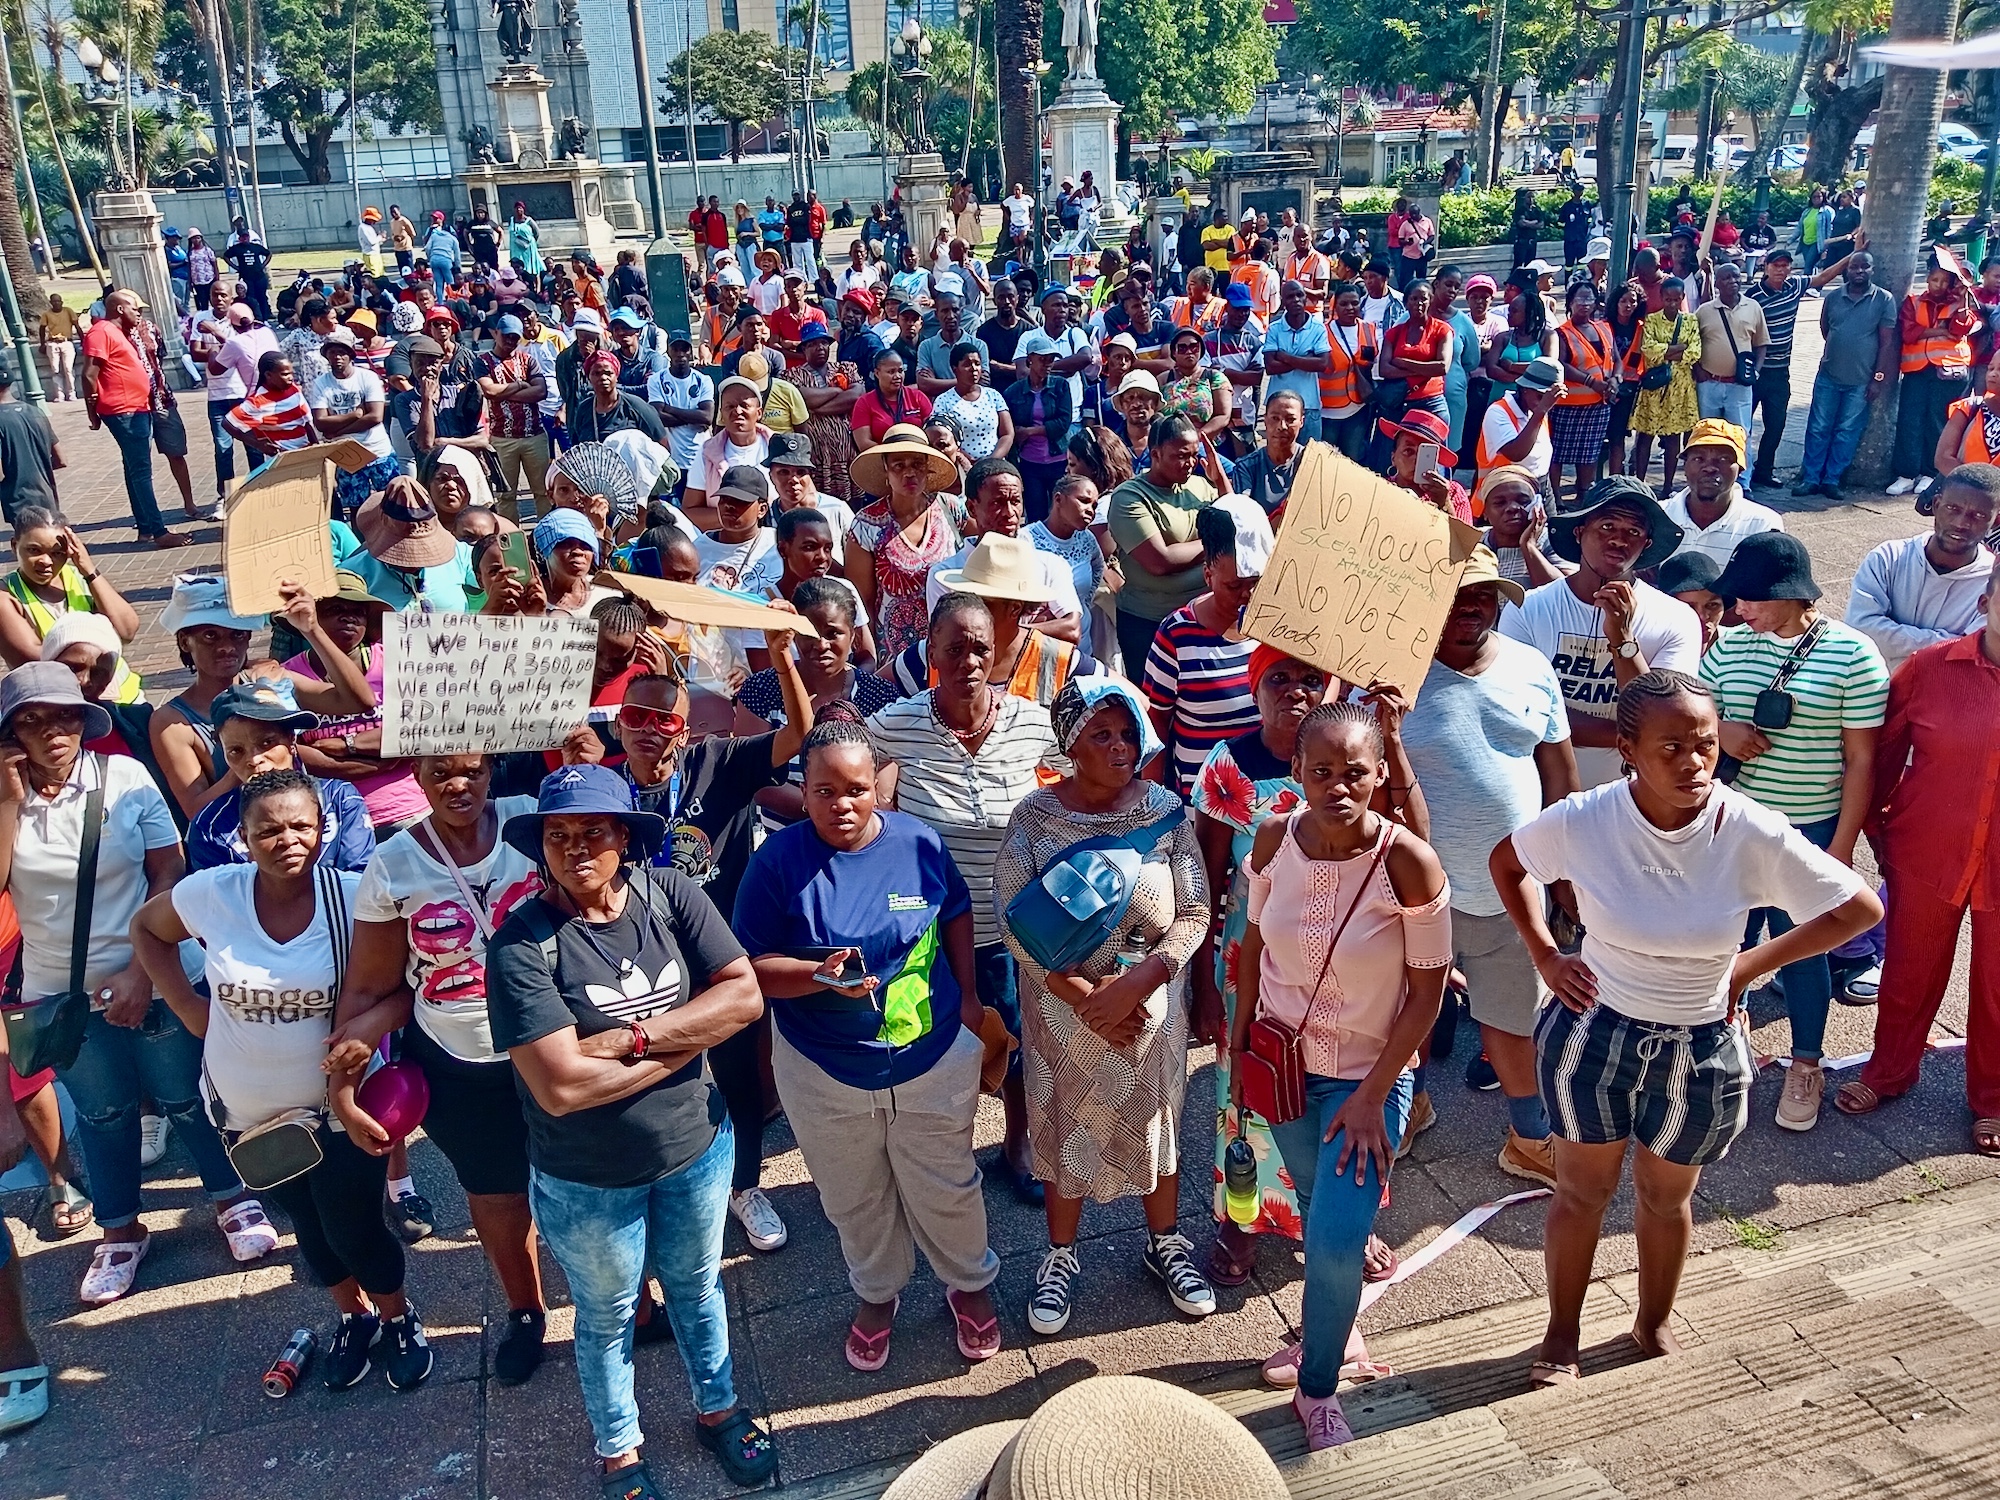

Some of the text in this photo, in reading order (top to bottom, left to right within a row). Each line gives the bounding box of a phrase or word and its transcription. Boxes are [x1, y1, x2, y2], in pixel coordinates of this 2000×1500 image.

[1291, 453, 1456, 594] No house
[1273, 554, 1429, 659] No Vote
[539, 619, 559, 632] us
[1246, 603, 1320, 656] Floods
[478, 631, 519, 653] have
[532, 636, 553, 651] an
[470, 654, 489, 679] of
[397, 676, 428, 699] We
[560, 676, 585, 695] for
[551, 699, 576, 713] are
[399, 720, 466, 741] affected
[475, 719, 496, 742] by
[510, 716, 537, 734] the
[399, 740, 422, 756] We
[433, 739, 473, 755] want
[483, 738, 507, 754] our
[1641, 864, 1685, 878] REDBAT
